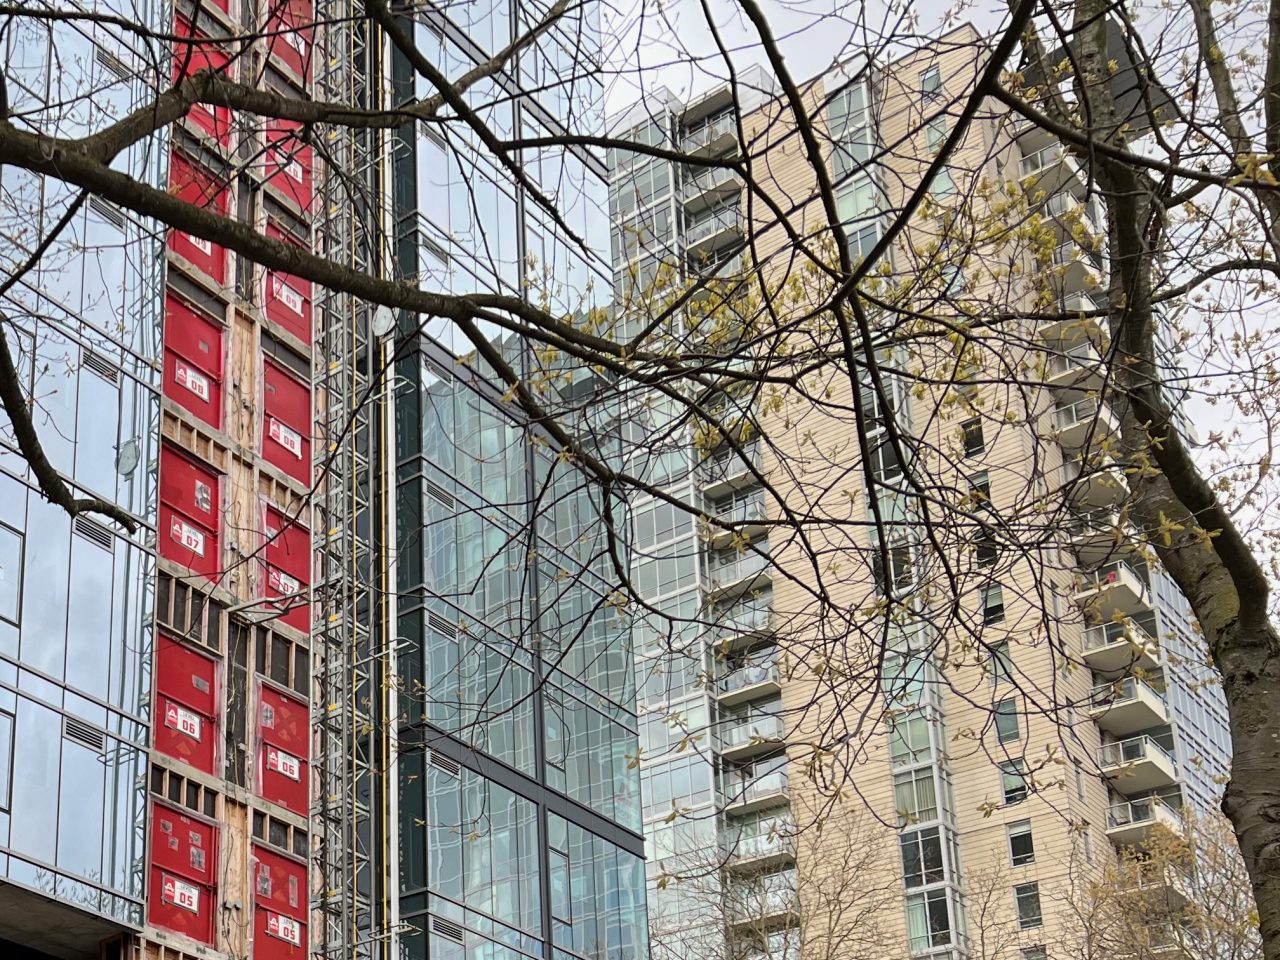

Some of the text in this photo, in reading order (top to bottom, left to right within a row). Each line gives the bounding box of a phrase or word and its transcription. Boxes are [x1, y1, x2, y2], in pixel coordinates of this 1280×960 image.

[187, 535, 199, 552] 07
[182, 720, 195, 735] 06
[282, 762, 295, 775] 06
[180, 893, 193, 907] 05
[283, 927, 296, 940] 05
